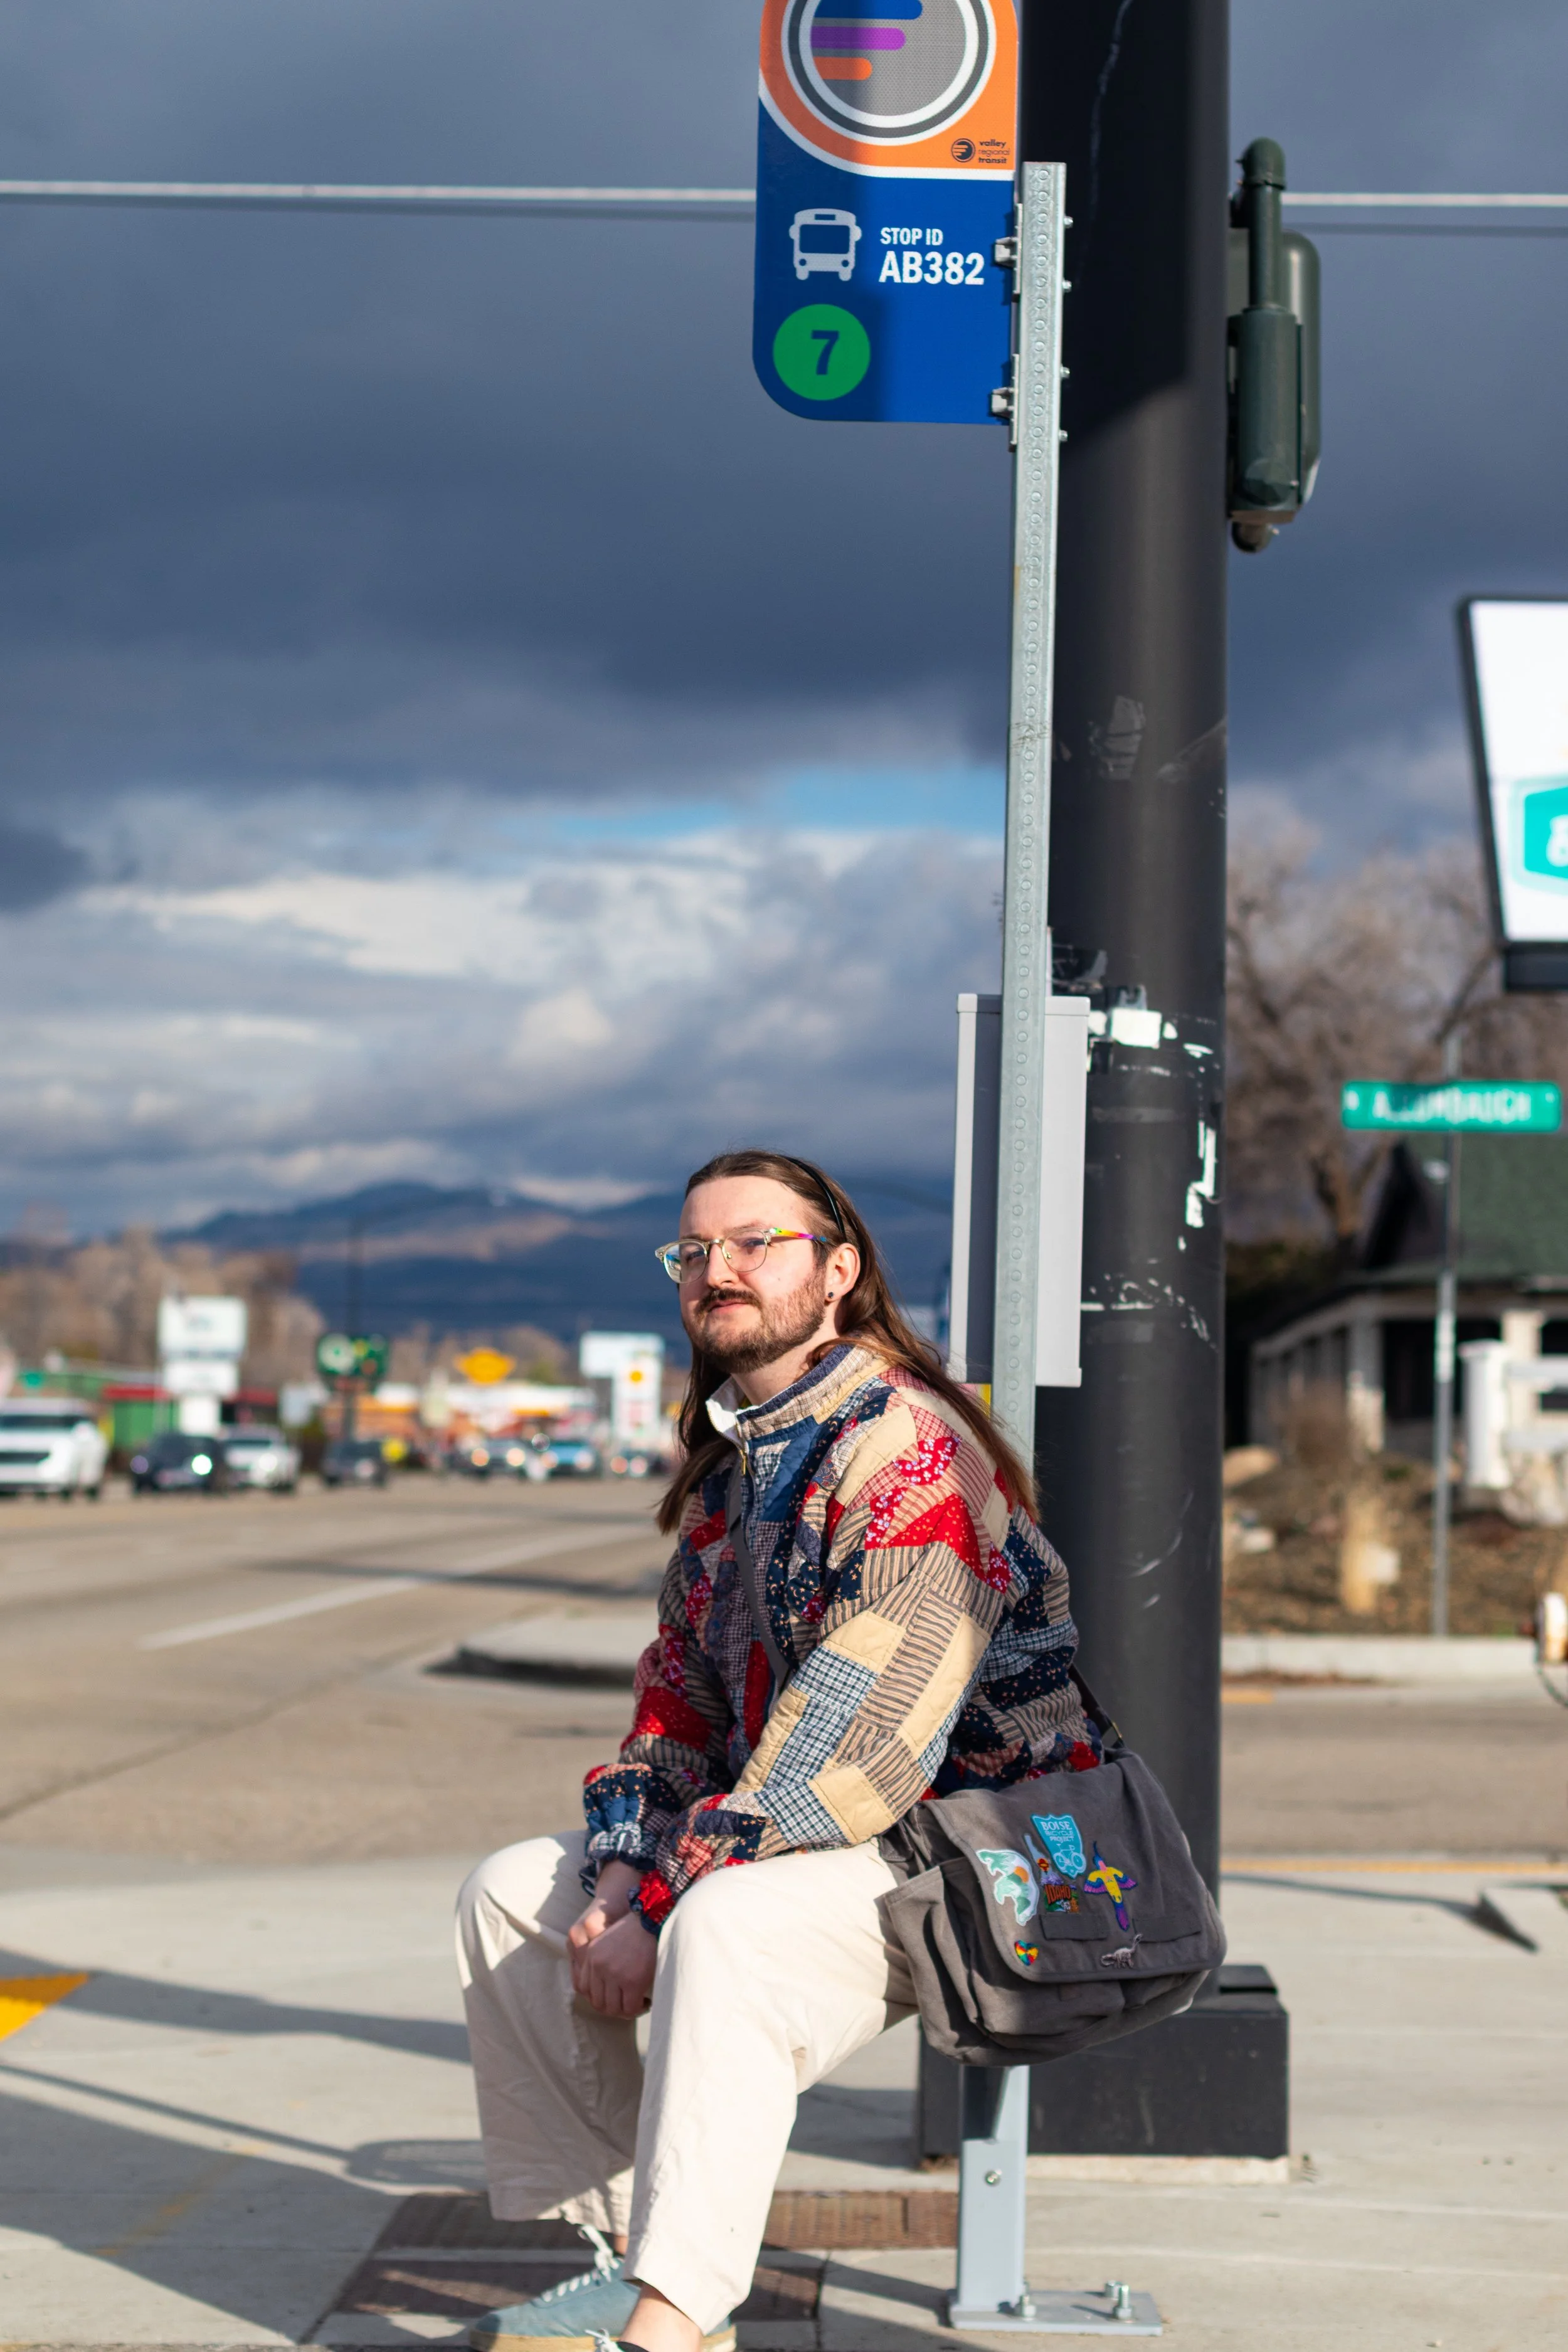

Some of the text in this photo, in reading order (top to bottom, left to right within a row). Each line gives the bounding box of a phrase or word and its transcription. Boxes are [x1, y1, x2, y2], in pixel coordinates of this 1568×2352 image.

[978, 147, 1010, 157] regional
[979, 139, 1006, 149] valley
[880, 227, 943, 246] STOP ID
[878, 250, 985, 285] AB382
[810, 329, 840, 376] 7
[1041, 1821, 1072, 1830] BOISE
[1044, 1884, 1071, 1904] IDAHO
